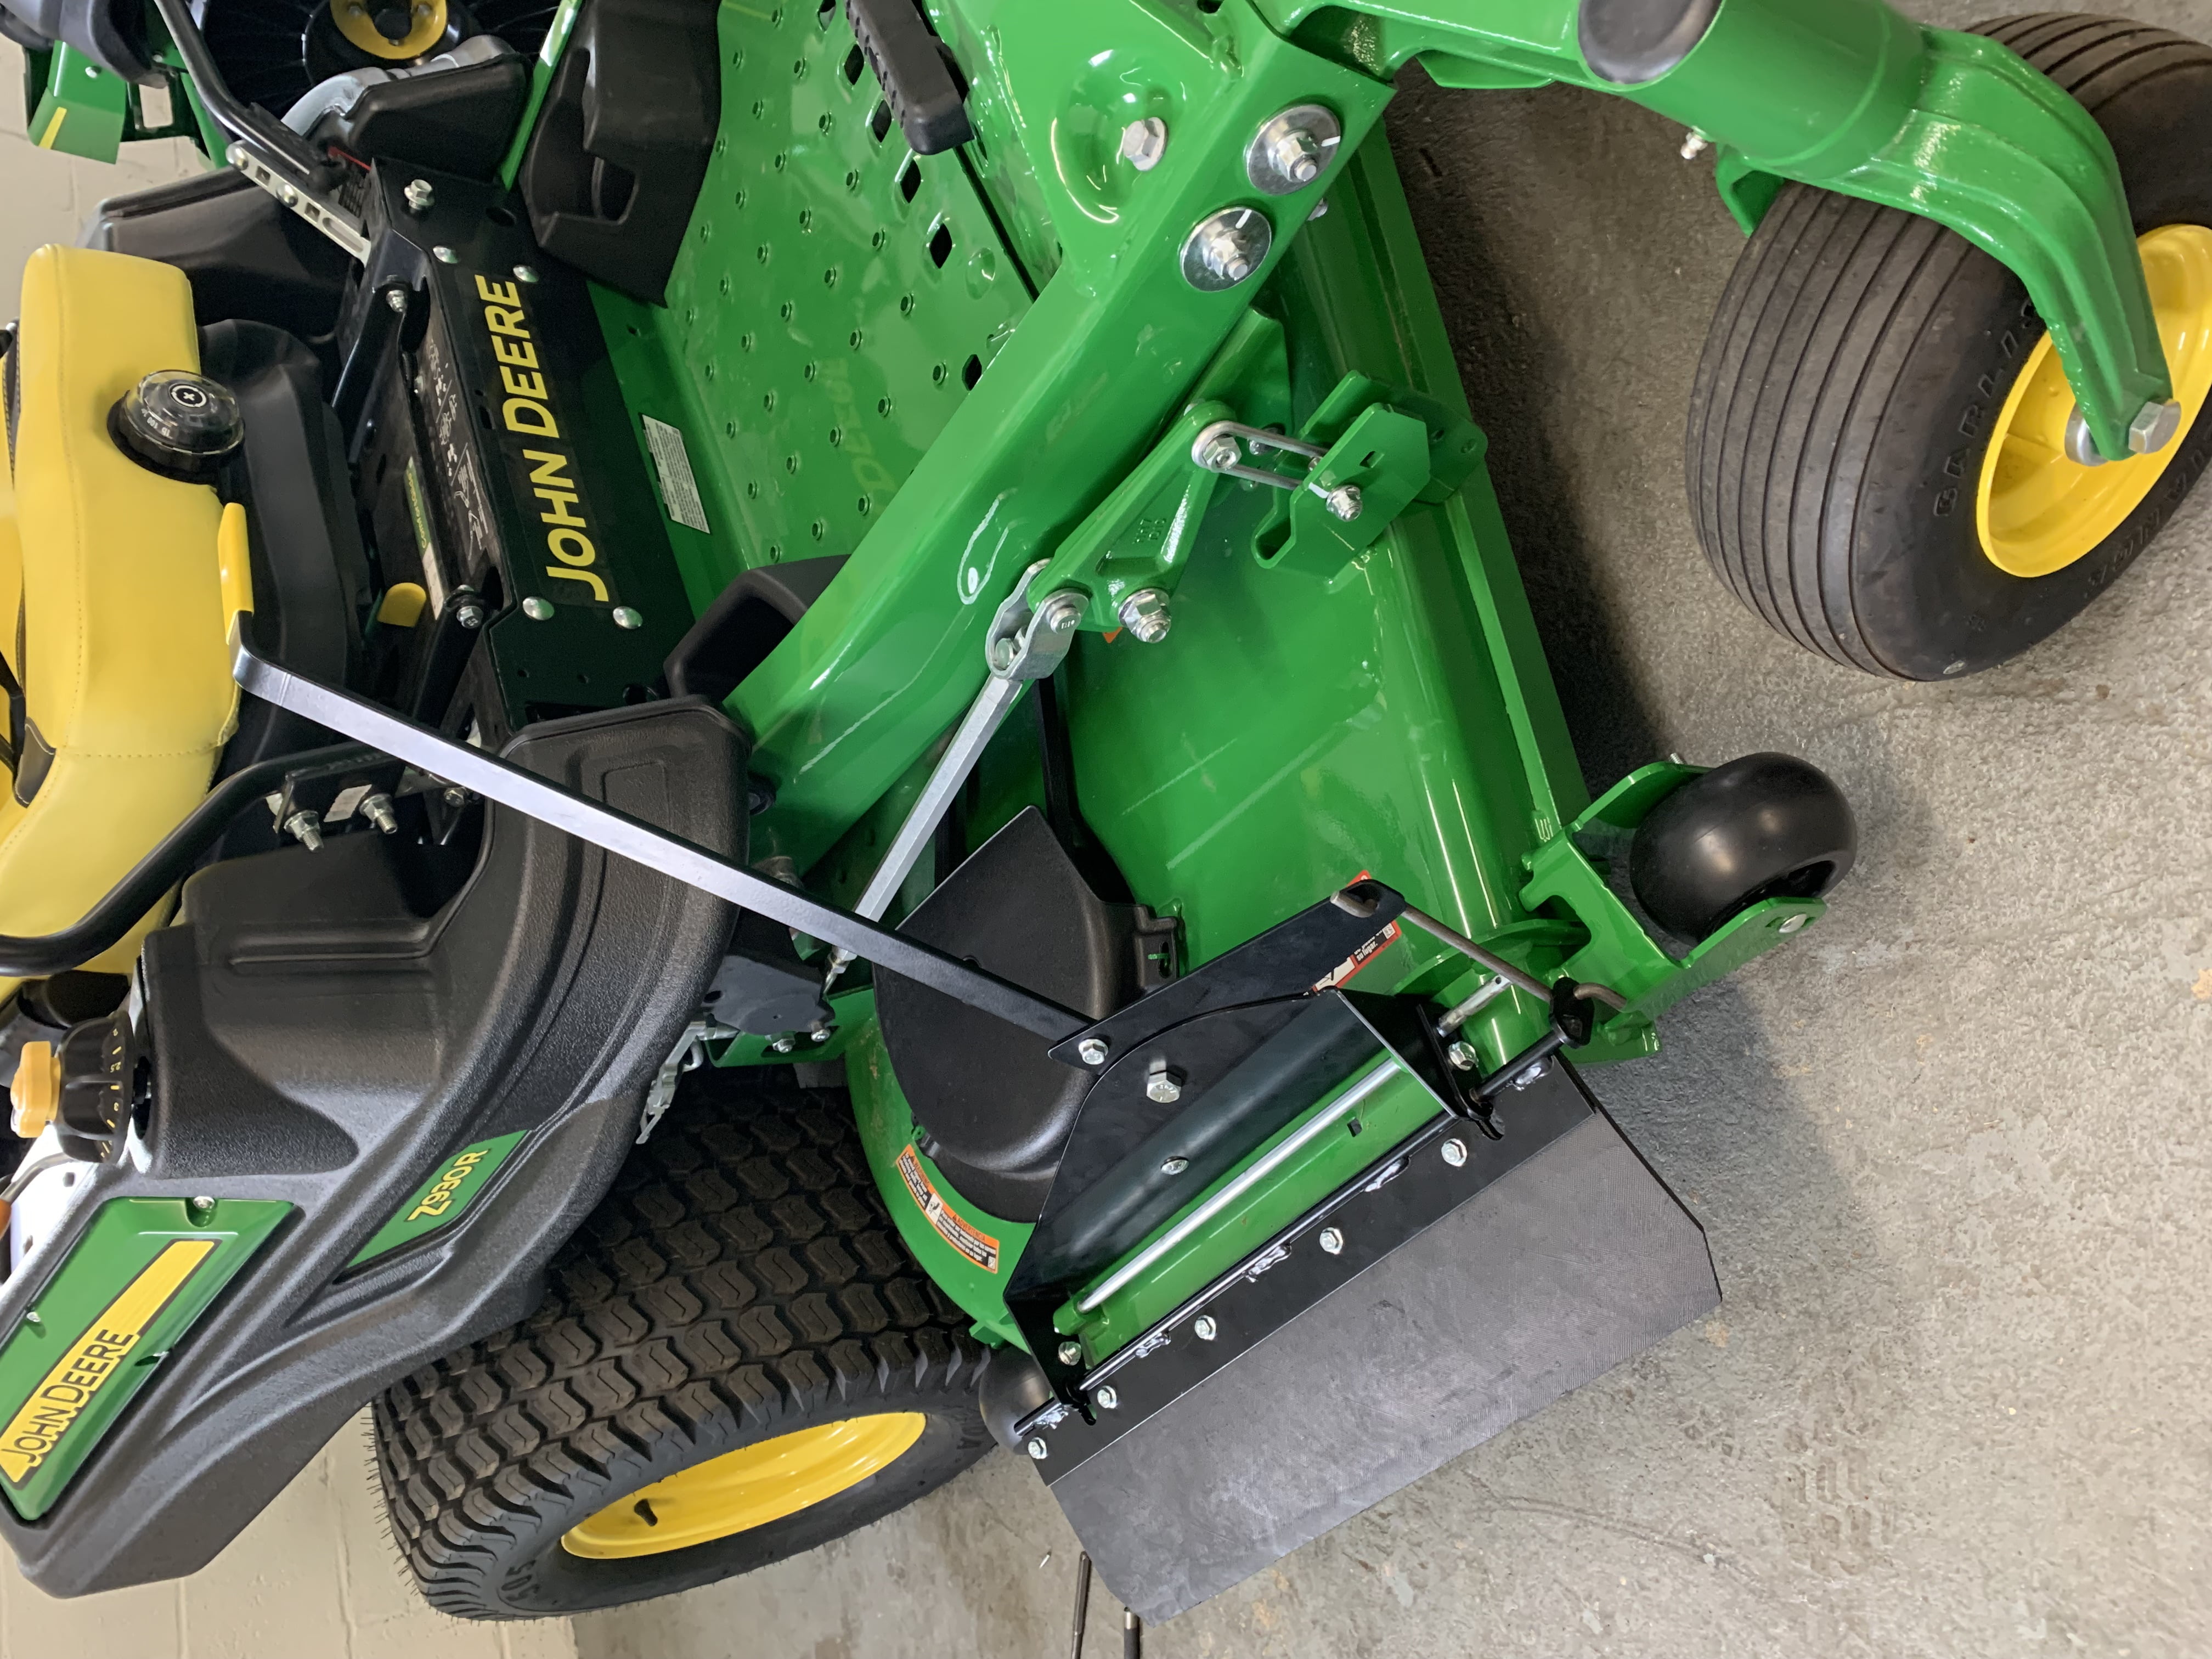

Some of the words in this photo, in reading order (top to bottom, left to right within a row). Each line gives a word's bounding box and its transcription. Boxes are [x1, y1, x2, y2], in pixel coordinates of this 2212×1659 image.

[475, 274, 559, 438] DEERE
[523, 449, 608, 602] JOHN
[407, 1149, 489, 1222] Z930R
[1, 1406, 71, 1464] JOHN
[40, 1329, 134, 1404] DEERE
